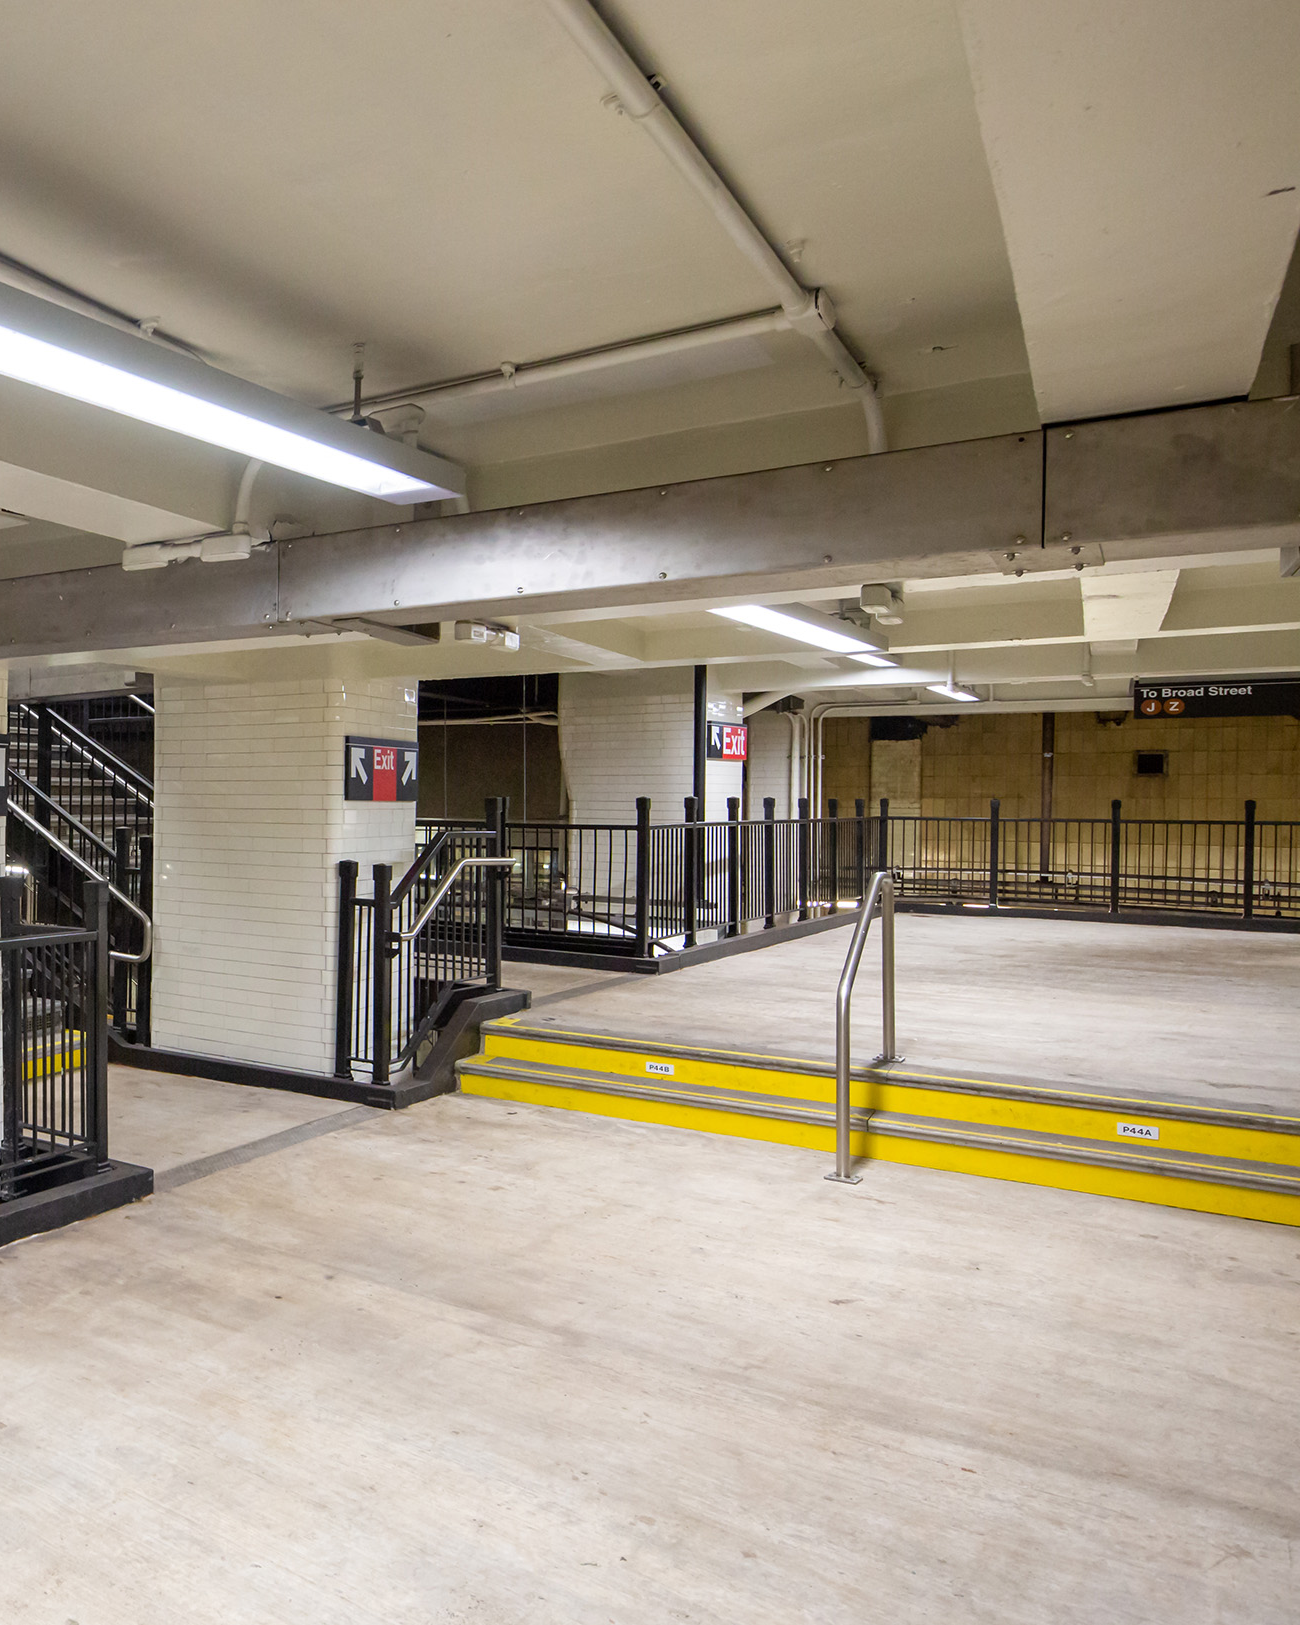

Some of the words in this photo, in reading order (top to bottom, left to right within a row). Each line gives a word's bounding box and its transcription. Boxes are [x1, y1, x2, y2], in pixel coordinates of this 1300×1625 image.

[1140, 689, 1157, 698] To
[1161, 687, 1204, 698] Broad
[1208, 686, 1253, 697] Street
[1146, 702, 1156, 713] J
[1169, 701, 1179, 712] Z
[723, 727, 746, 756] Exit
[374, 748, 395, 771] Exit
[649, 1064, 670, 1073] P44B
[1122, 1126, 1152, 1137] P44A
